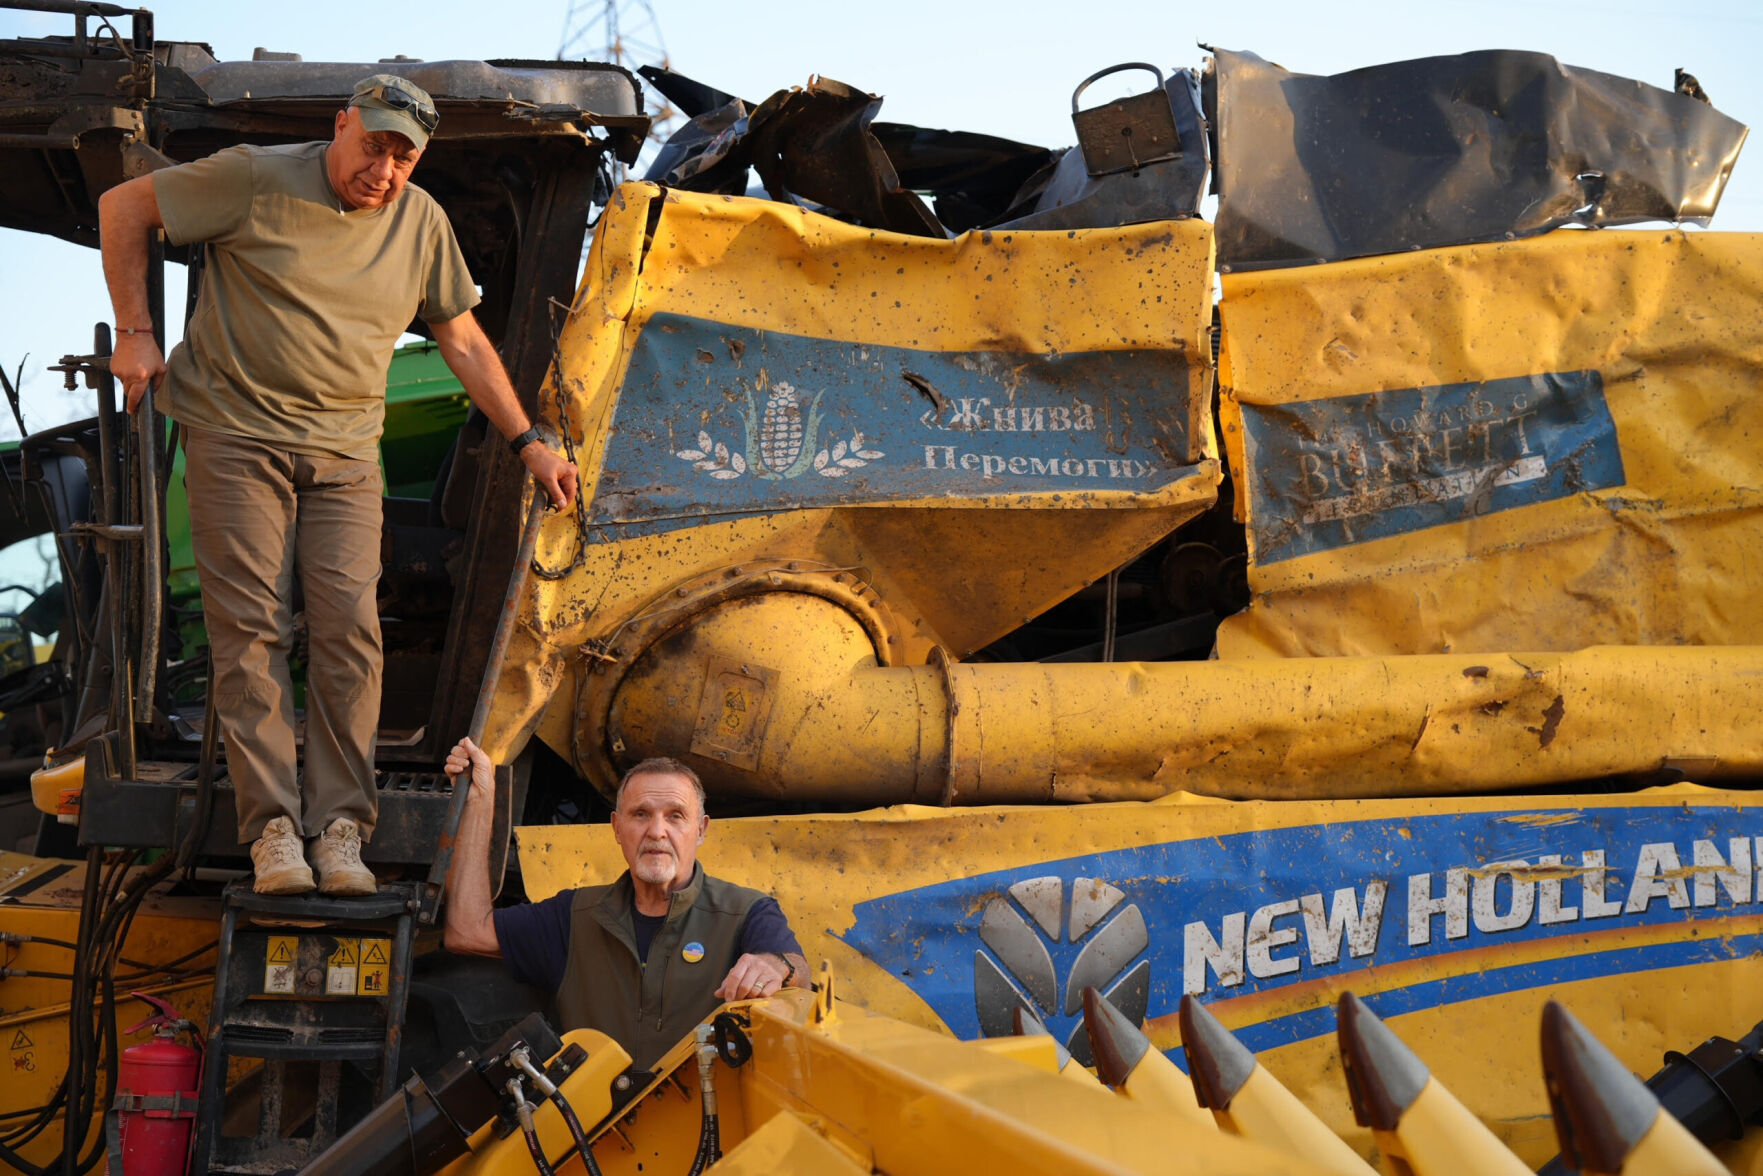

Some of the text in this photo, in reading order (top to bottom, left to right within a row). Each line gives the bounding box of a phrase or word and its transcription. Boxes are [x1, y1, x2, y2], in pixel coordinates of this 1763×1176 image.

[919, 397, 1096, 433] «Жнива
[921, 444, 1158, 479] Перемоги»
[1183, 836, 1763, 996] NEW HOLLAN
